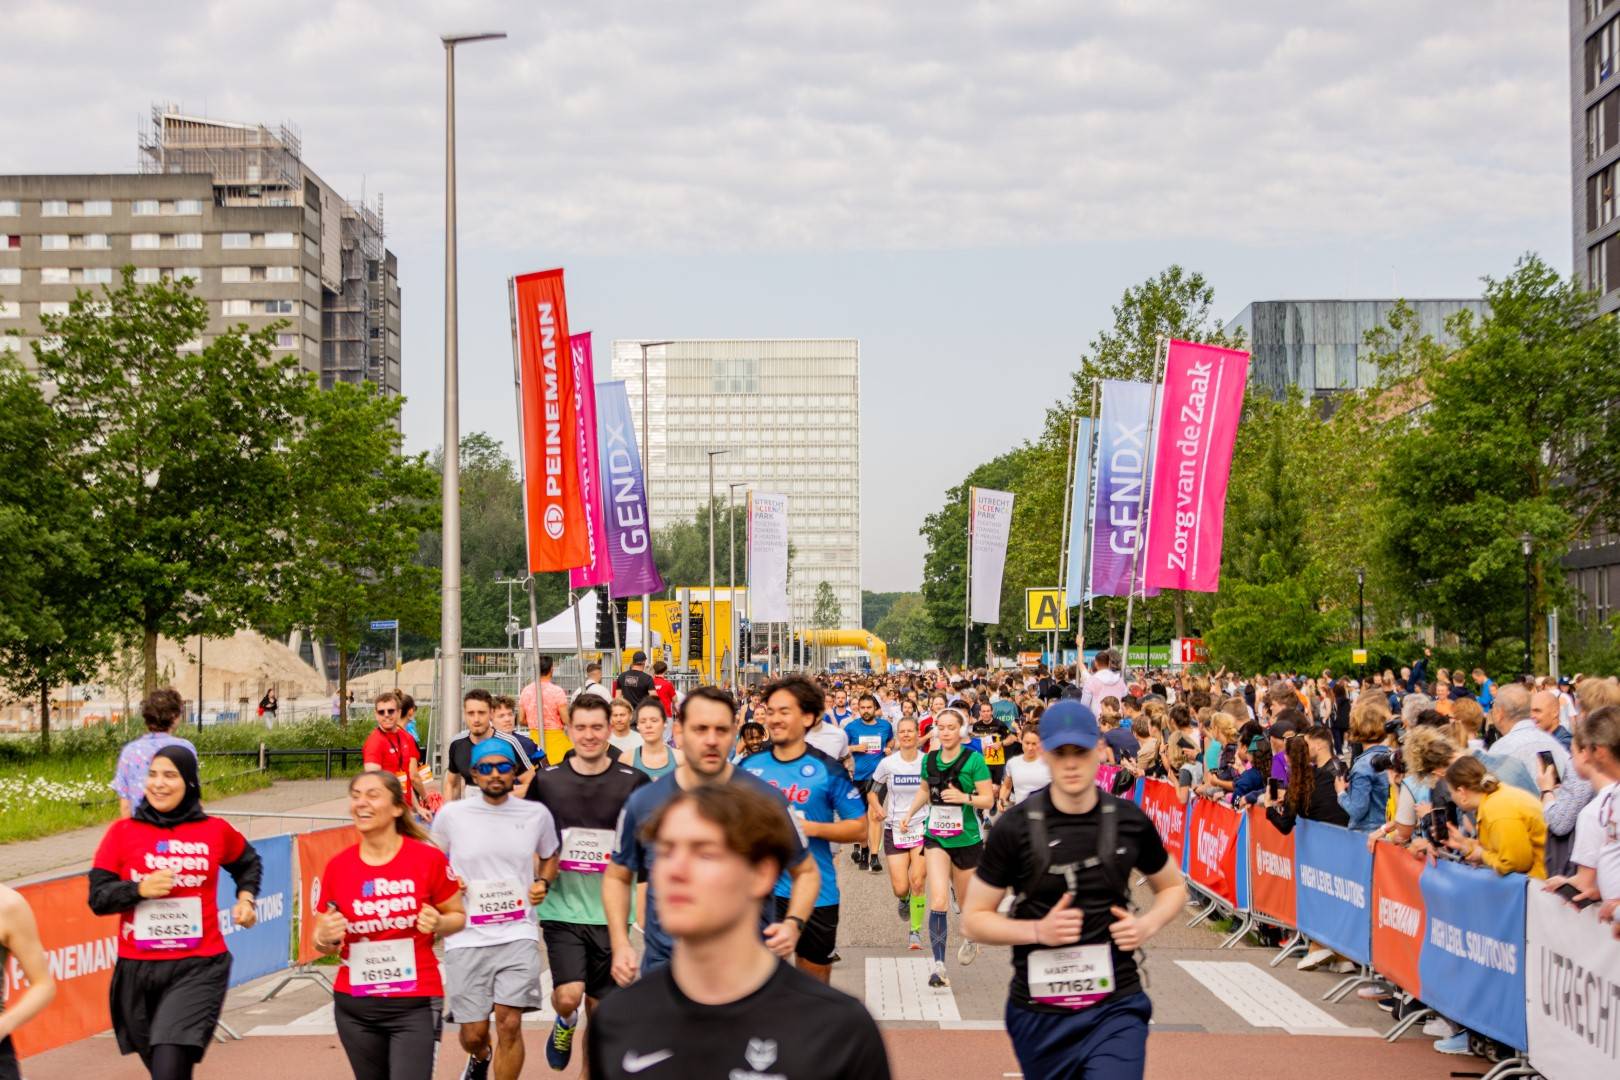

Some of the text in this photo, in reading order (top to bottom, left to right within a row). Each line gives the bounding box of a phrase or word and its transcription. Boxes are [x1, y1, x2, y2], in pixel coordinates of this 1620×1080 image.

[538, 302, 562, 496] PEINEMANN
[1168, 360, 1213, 570] Zorg van de Zaak
[605, 421, 648, 556] GENDX
[1109, 422, 1145, 555] GENDX
[978, 496, 1010, 507] UTRECHT
[1036, 595, 1062, 625] A
[1182, 640, 1192, 661] 1
[143, 852, 210, 874] tegen
[569, 850, 603, 861] 17208
[351, 896, 418, 918] tegen
[479, 900, 517, 913] 16246
[147, 924, 191, 937] 16452
[1465, 930, 1518, 976] SOLUTIONS
[361, 967, 403, 982] 16194
[1047, 978, 1095, 994] 17162
[1540, 944, 1620, 1061] UTRECHT
